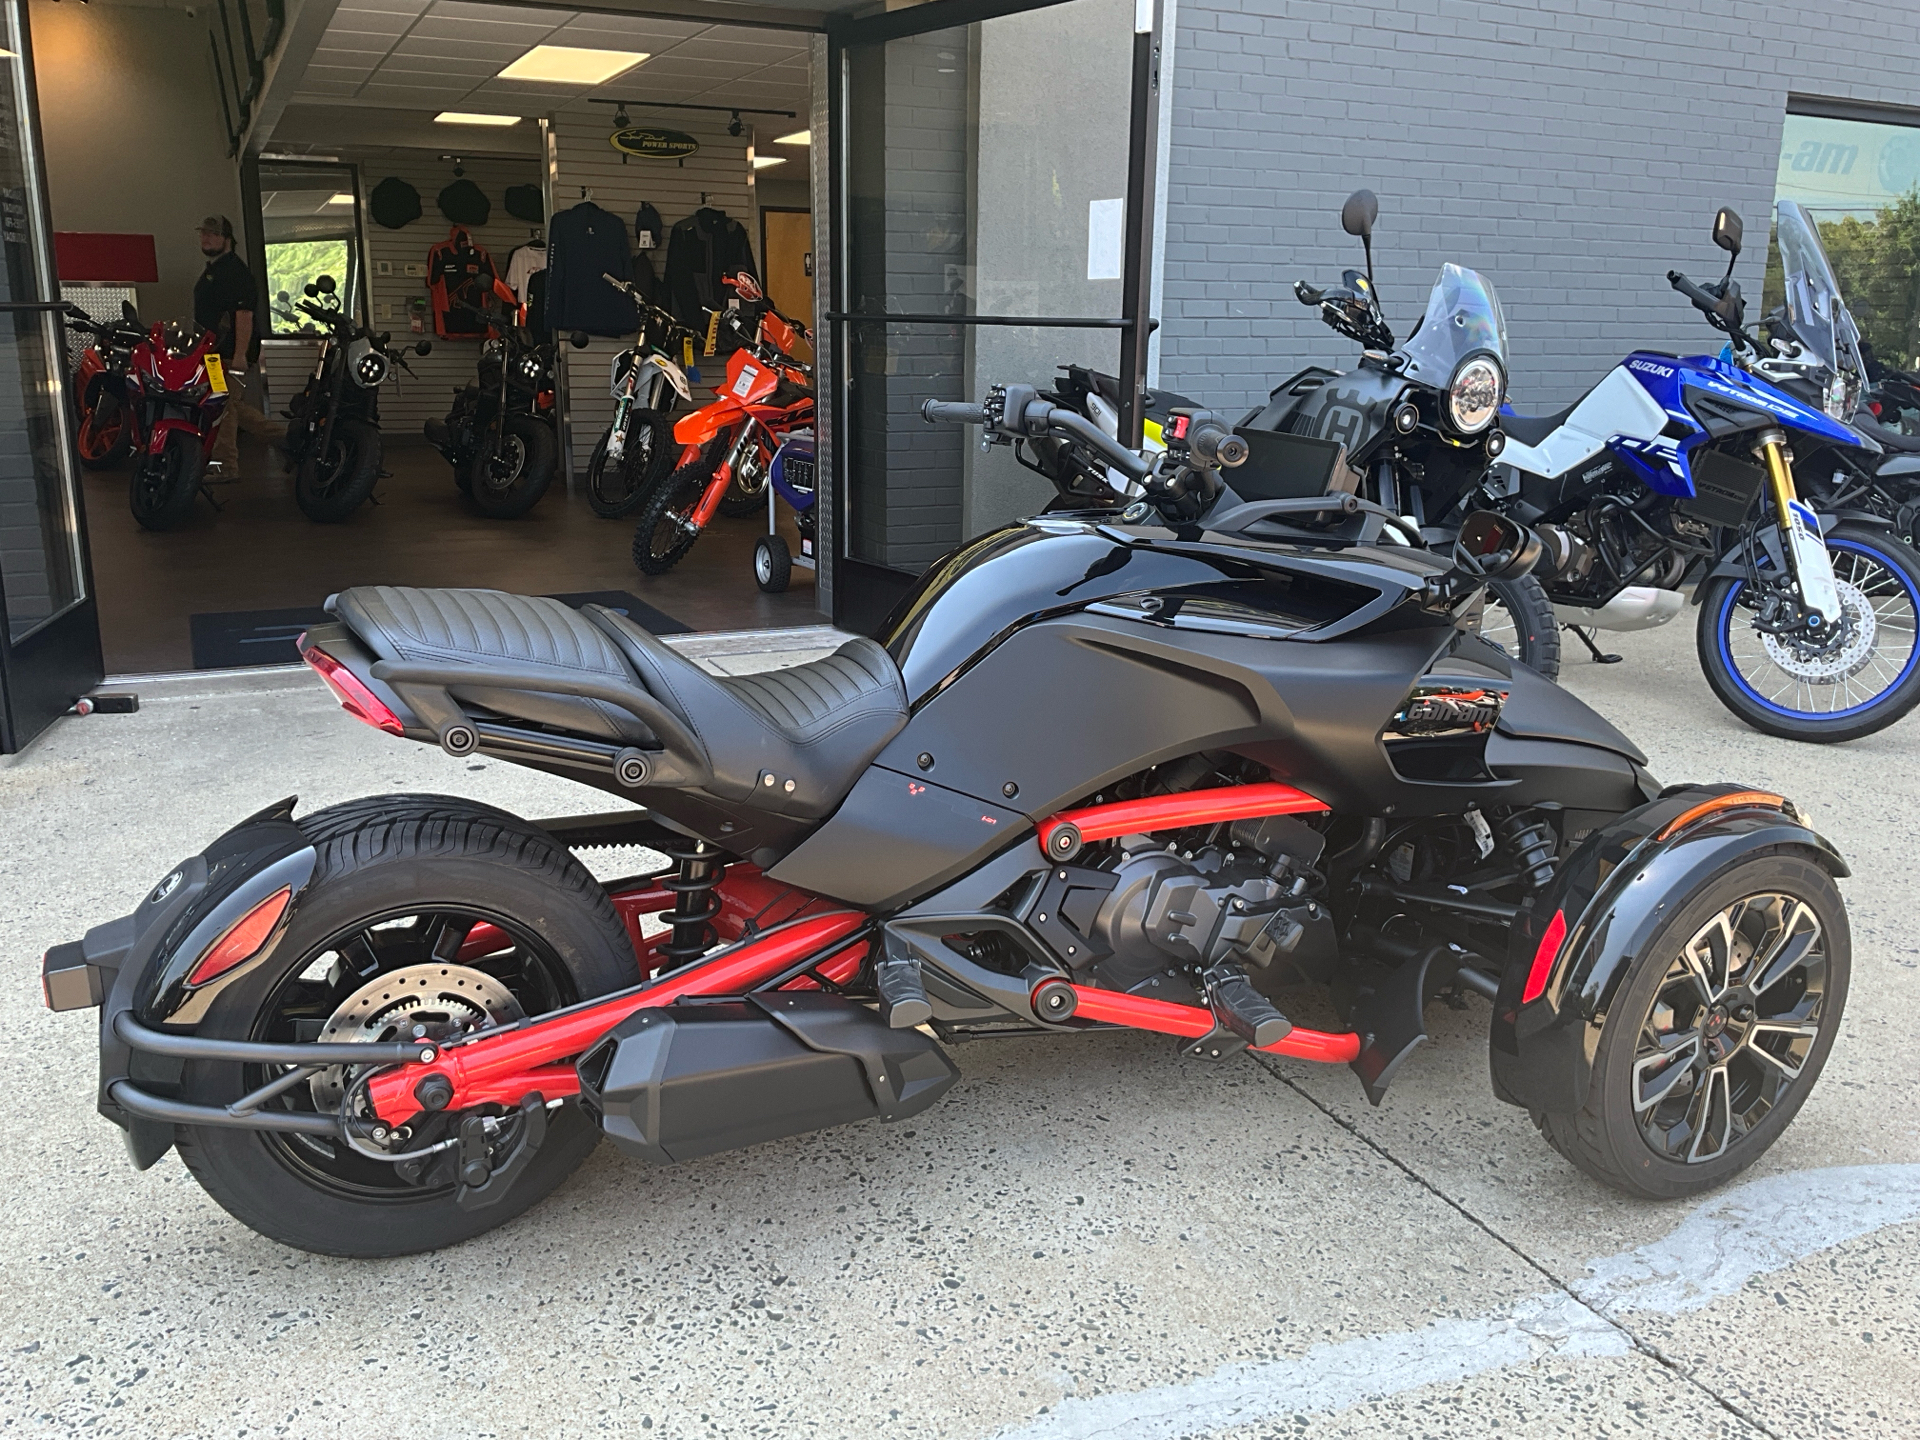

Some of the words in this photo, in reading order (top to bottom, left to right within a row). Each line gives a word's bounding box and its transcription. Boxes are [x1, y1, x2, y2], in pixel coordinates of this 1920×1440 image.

[669, 142, 696, 150] SPORTS
[1629, 360, 1675, 378] SUZUKI
[1698, 481, 1736, 498] V-STROM
[1792, 512, 1805, 541] 1050
[1408, 702, 1493, 724] can-am
